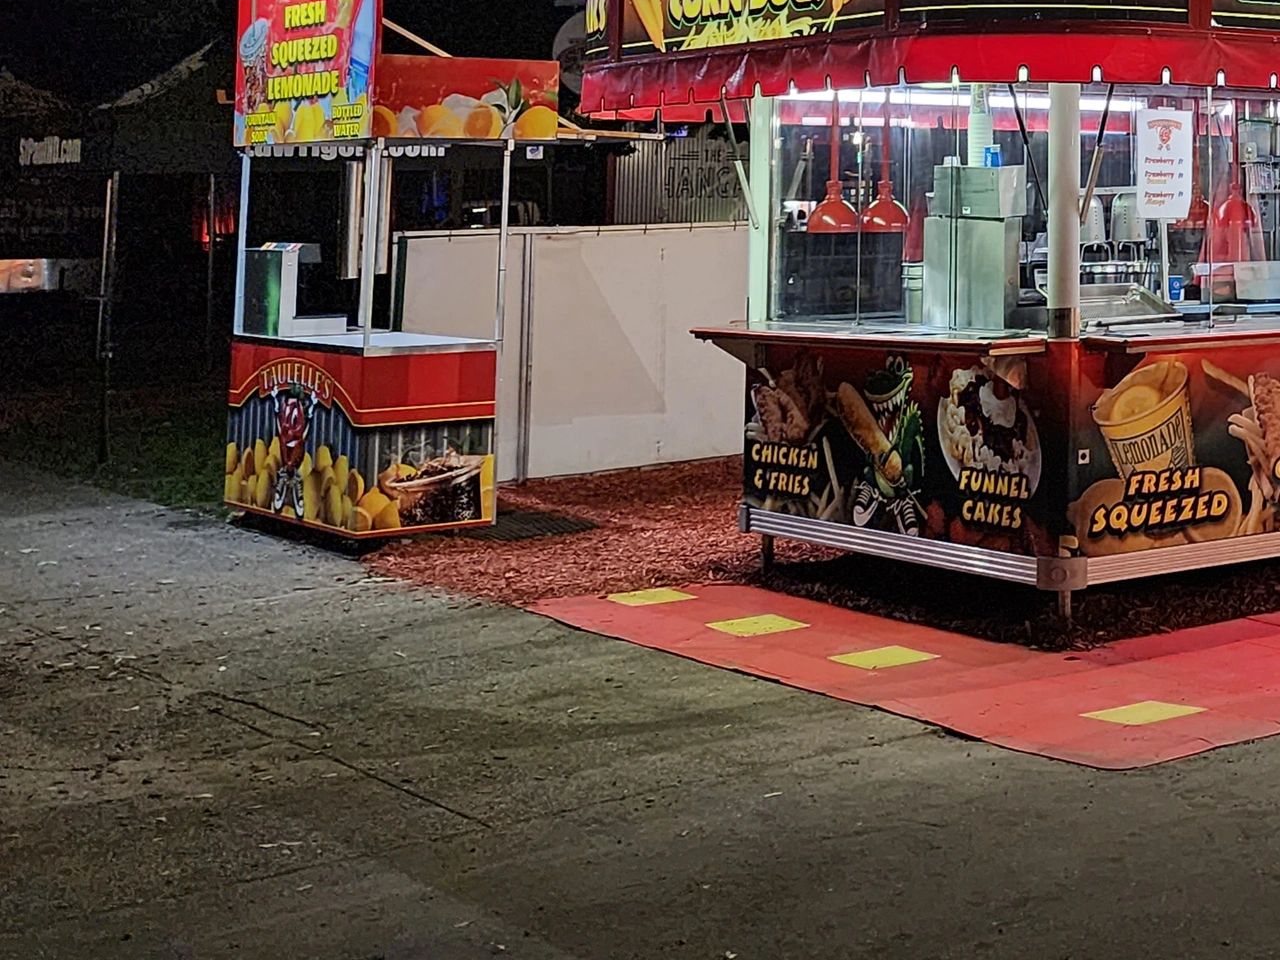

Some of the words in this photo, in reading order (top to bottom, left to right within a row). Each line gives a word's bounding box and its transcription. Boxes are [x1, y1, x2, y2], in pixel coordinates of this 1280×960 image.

[284, 0, 326, 29] FRESH
[271, 34, 338, 69] SQUEEZED
[267, 70, 339, 102] LEMONADE
[332, 104, 363, 120] BOTTLED
[333, 123, 360, 138] WATER
[751, 444, 818, 470] CHICKEN
[754, 472, 763, 487] &
[766, 473, 811, 496] FRIES
[959, 470, 1029, 500] FUNNEL
[1127, 466, 1200, 496] FRESH
[962, 500, 1022, 529] CAKES
[1091, 493, 1229, 533] SQUEEZED
